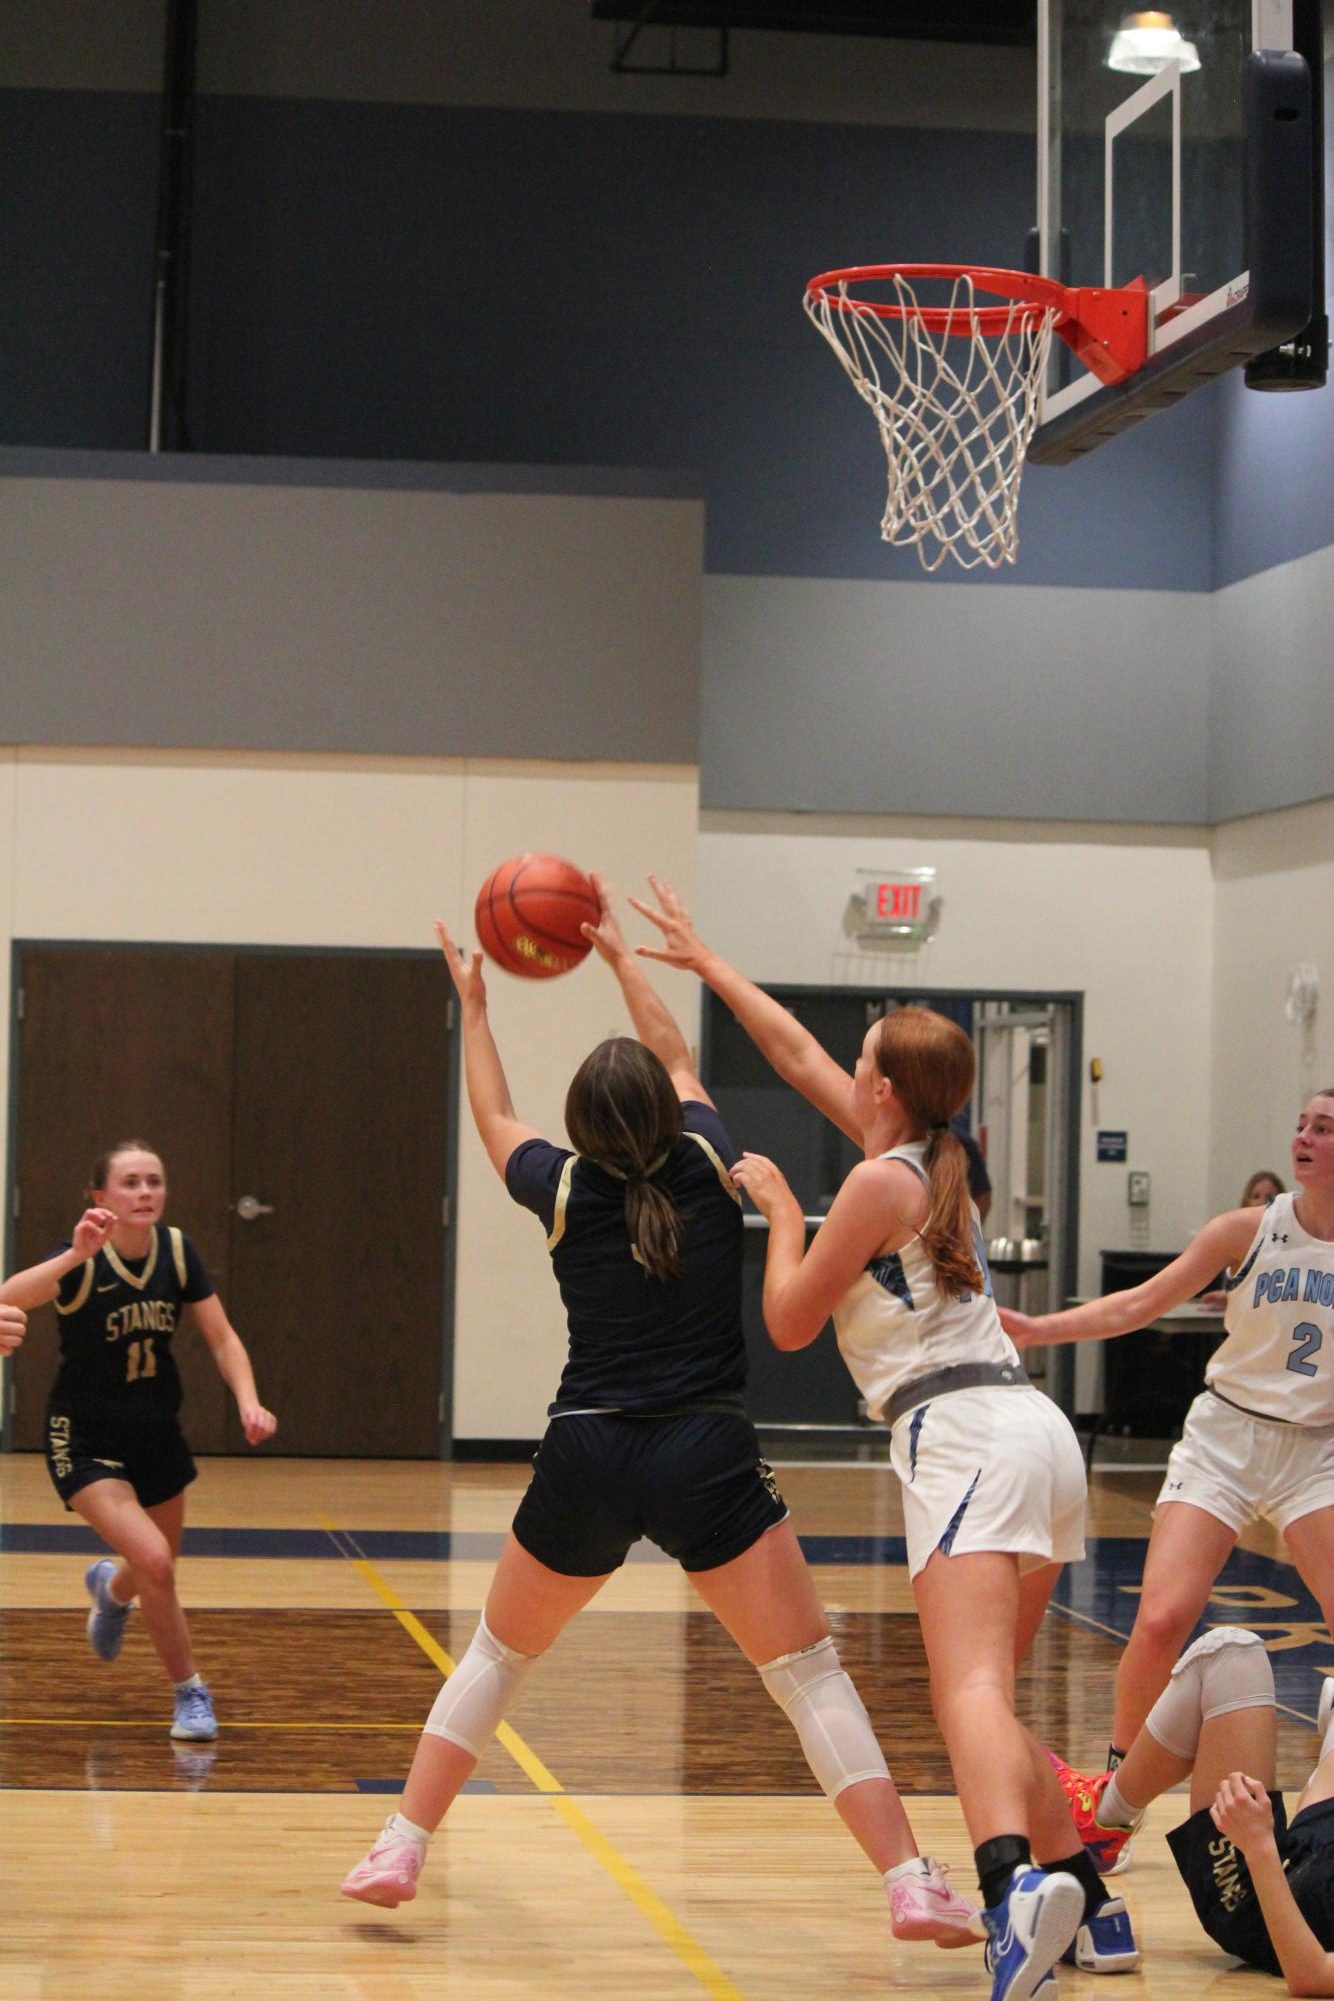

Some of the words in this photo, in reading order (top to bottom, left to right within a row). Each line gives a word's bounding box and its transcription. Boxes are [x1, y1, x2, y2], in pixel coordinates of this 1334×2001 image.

[877, 884, 923, 918] EXIT
[1303, 1269, 1334, 1309] NO
[105, 1300, 175, 1342] STANGS
[126, 1338, 157, 1383] 11
[1286, 1322, 1323, 1377] 2
